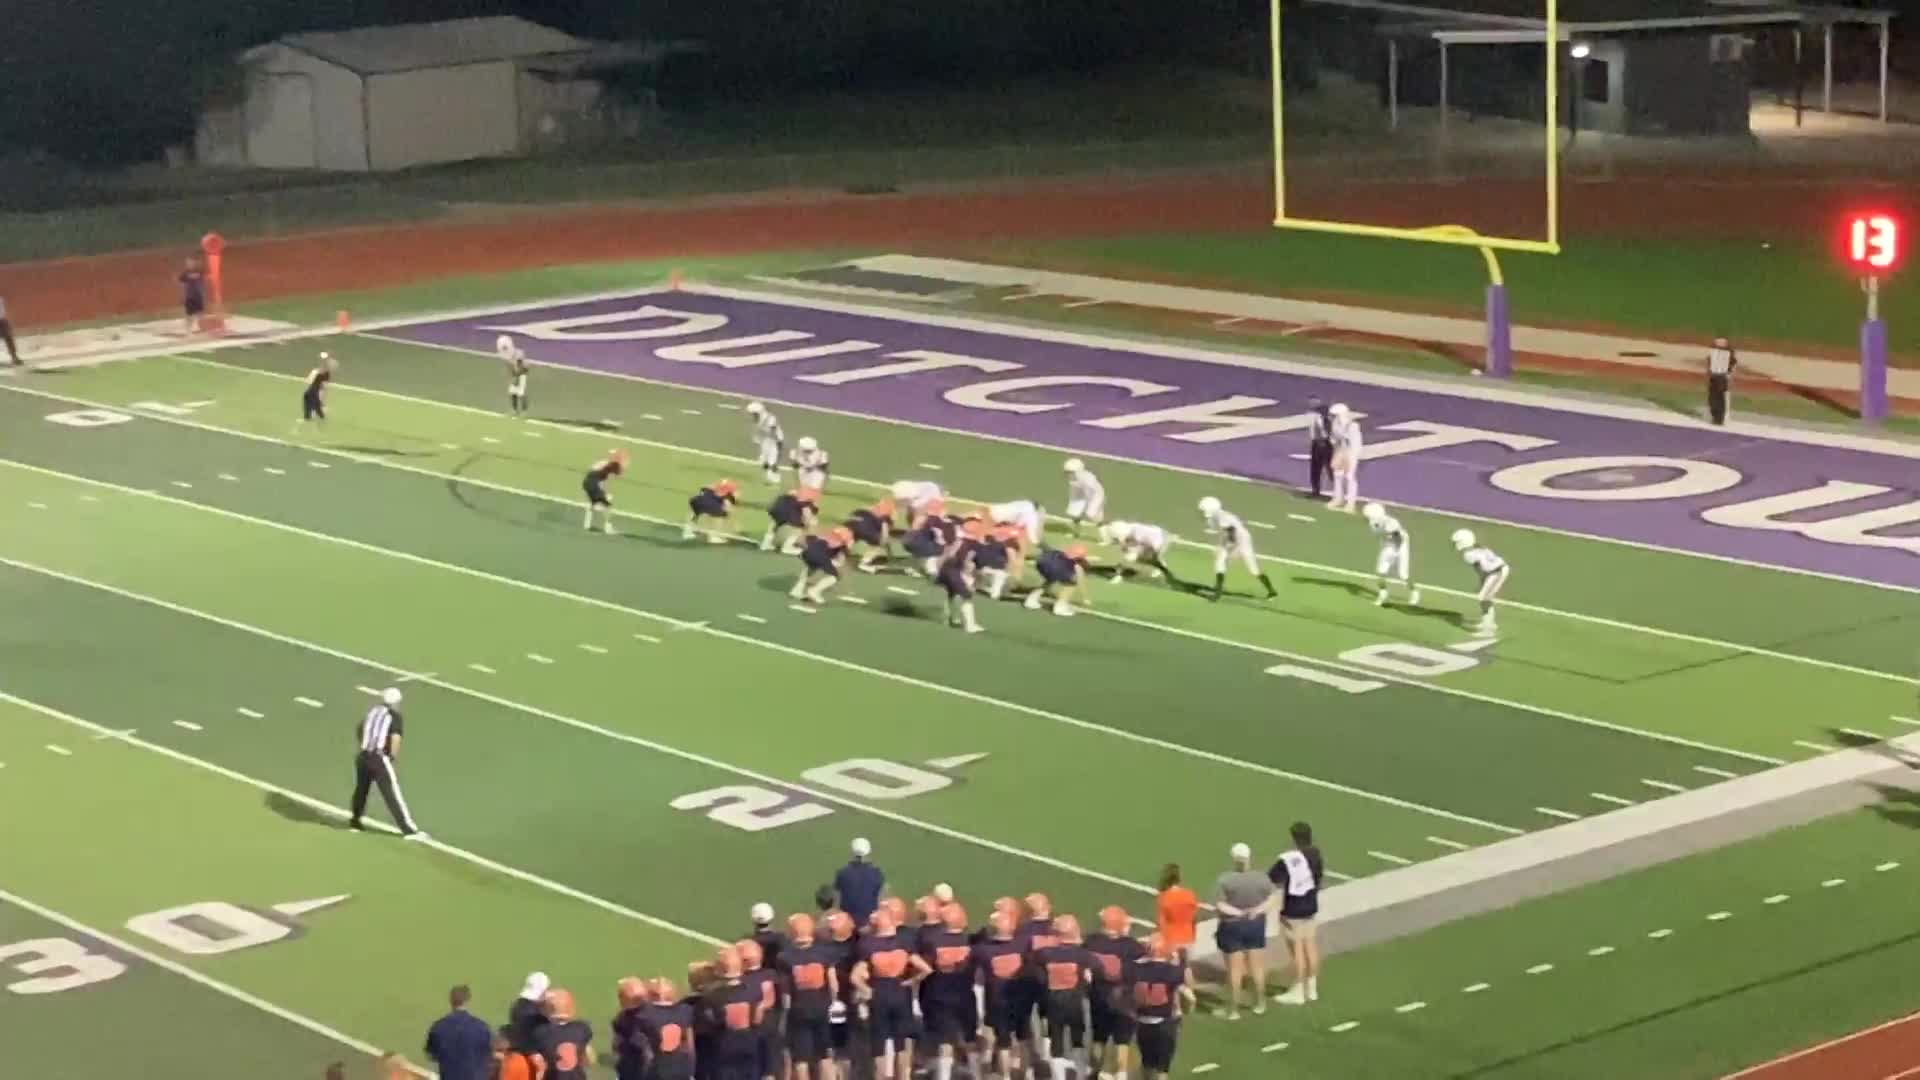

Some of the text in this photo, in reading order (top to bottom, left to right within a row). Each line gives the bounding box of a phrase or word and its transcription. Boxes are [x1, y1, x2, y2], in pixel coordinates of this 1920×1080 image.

[1852, 217, 1896, 267] 13
[1264, 642, 1481, 694] 10
[668, 757, 953, 832] 20
[0, 901, 292, 994] 30
